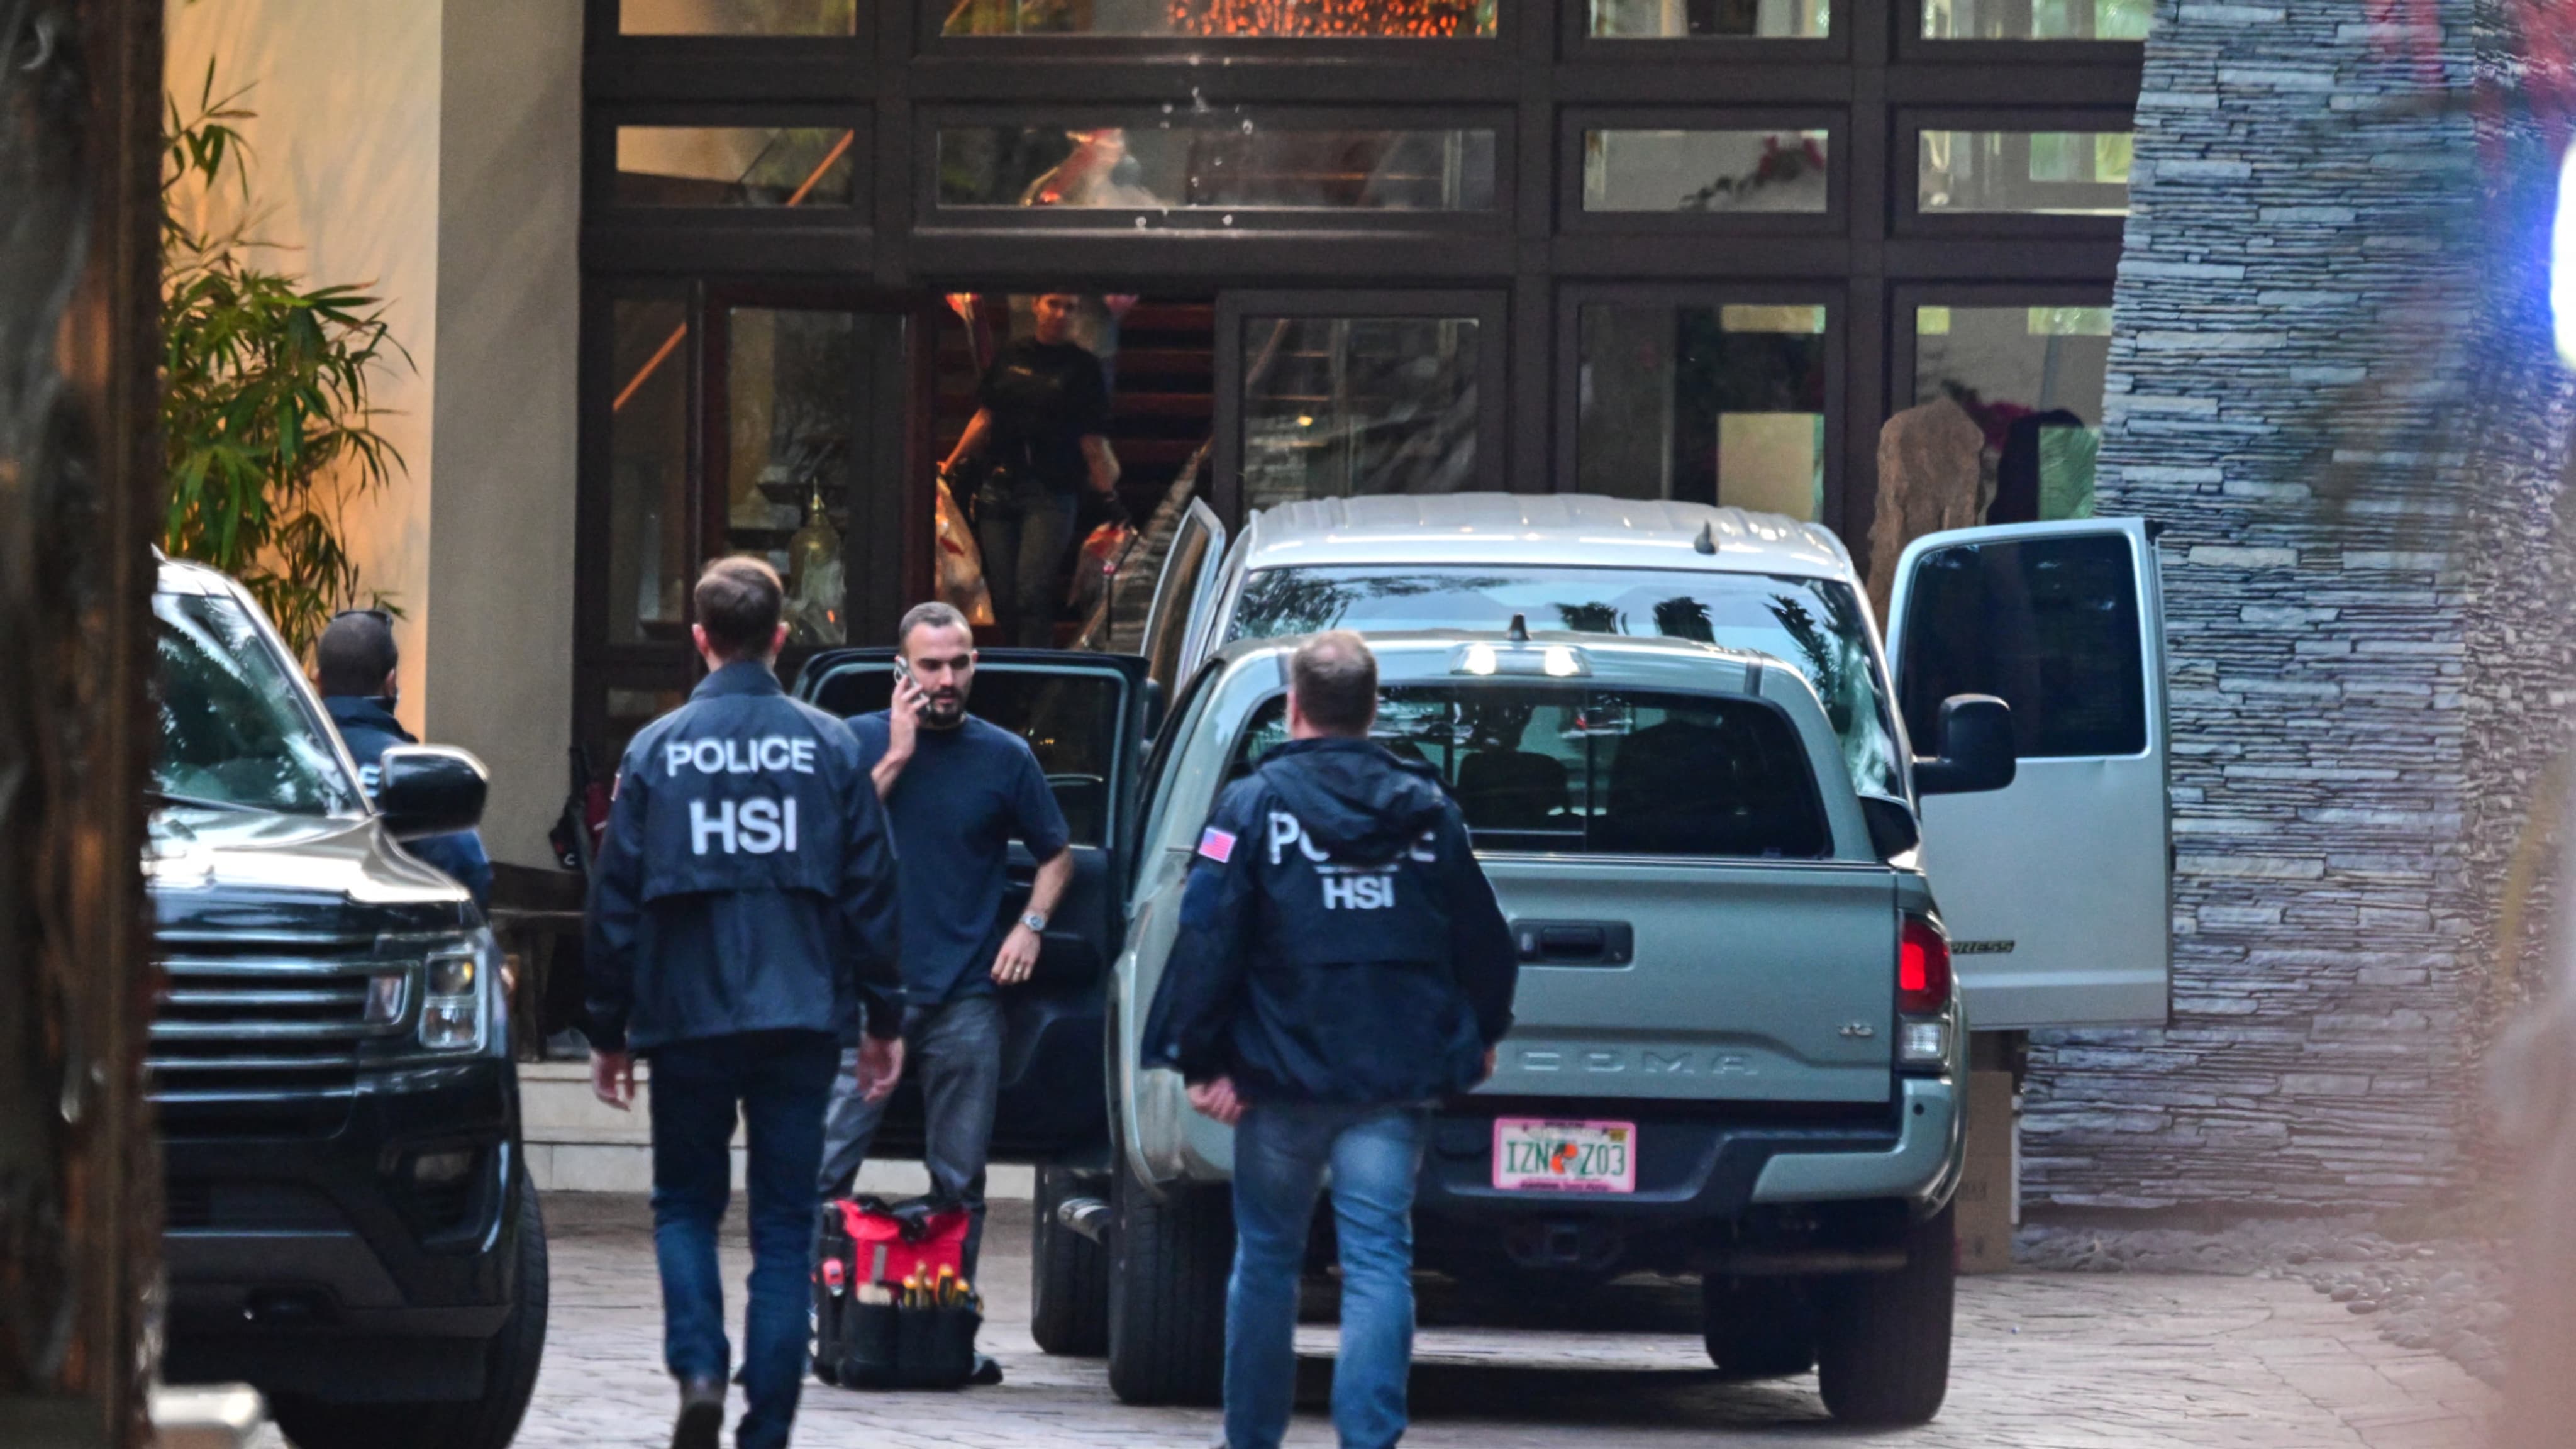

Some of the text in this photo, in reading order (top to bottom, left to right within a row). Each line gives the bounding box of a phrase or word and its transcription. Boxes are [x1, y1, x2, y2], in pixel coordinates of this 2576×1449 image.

[666, 736, 816, 777] POLICE
[689, 796, 797, 855] HSI
[1323, 875, 1395, 909] HSI
[1951, 942, 2014, 954] PRESS
[1516, 1050, 1760, 1075] COMA
[1506, 1141, 1625, 1175] IZN Z03
